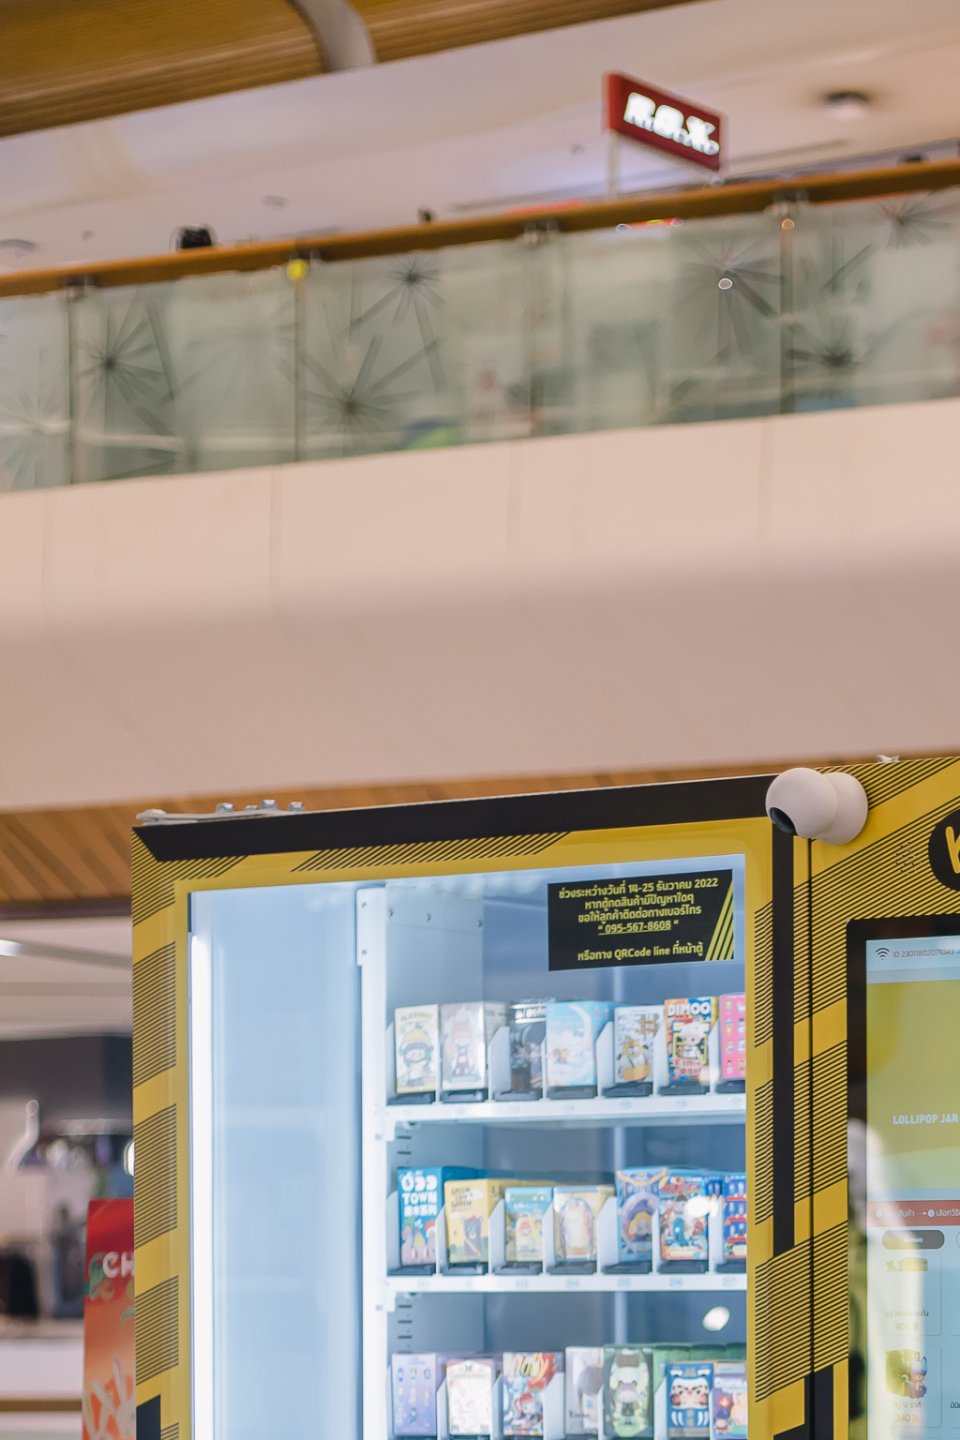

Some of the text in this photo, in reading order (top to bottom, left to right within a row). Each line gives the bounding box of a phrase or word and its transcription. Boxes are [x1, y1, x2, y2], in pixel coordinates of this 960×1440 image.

[656, 878, 692, 892] ธันวาคม
[694, 877, 718, 888] 2022
[614, 946, 651, 961] QRCode
[893, 1113, 959, 1125] LOLLIPOP JAR
